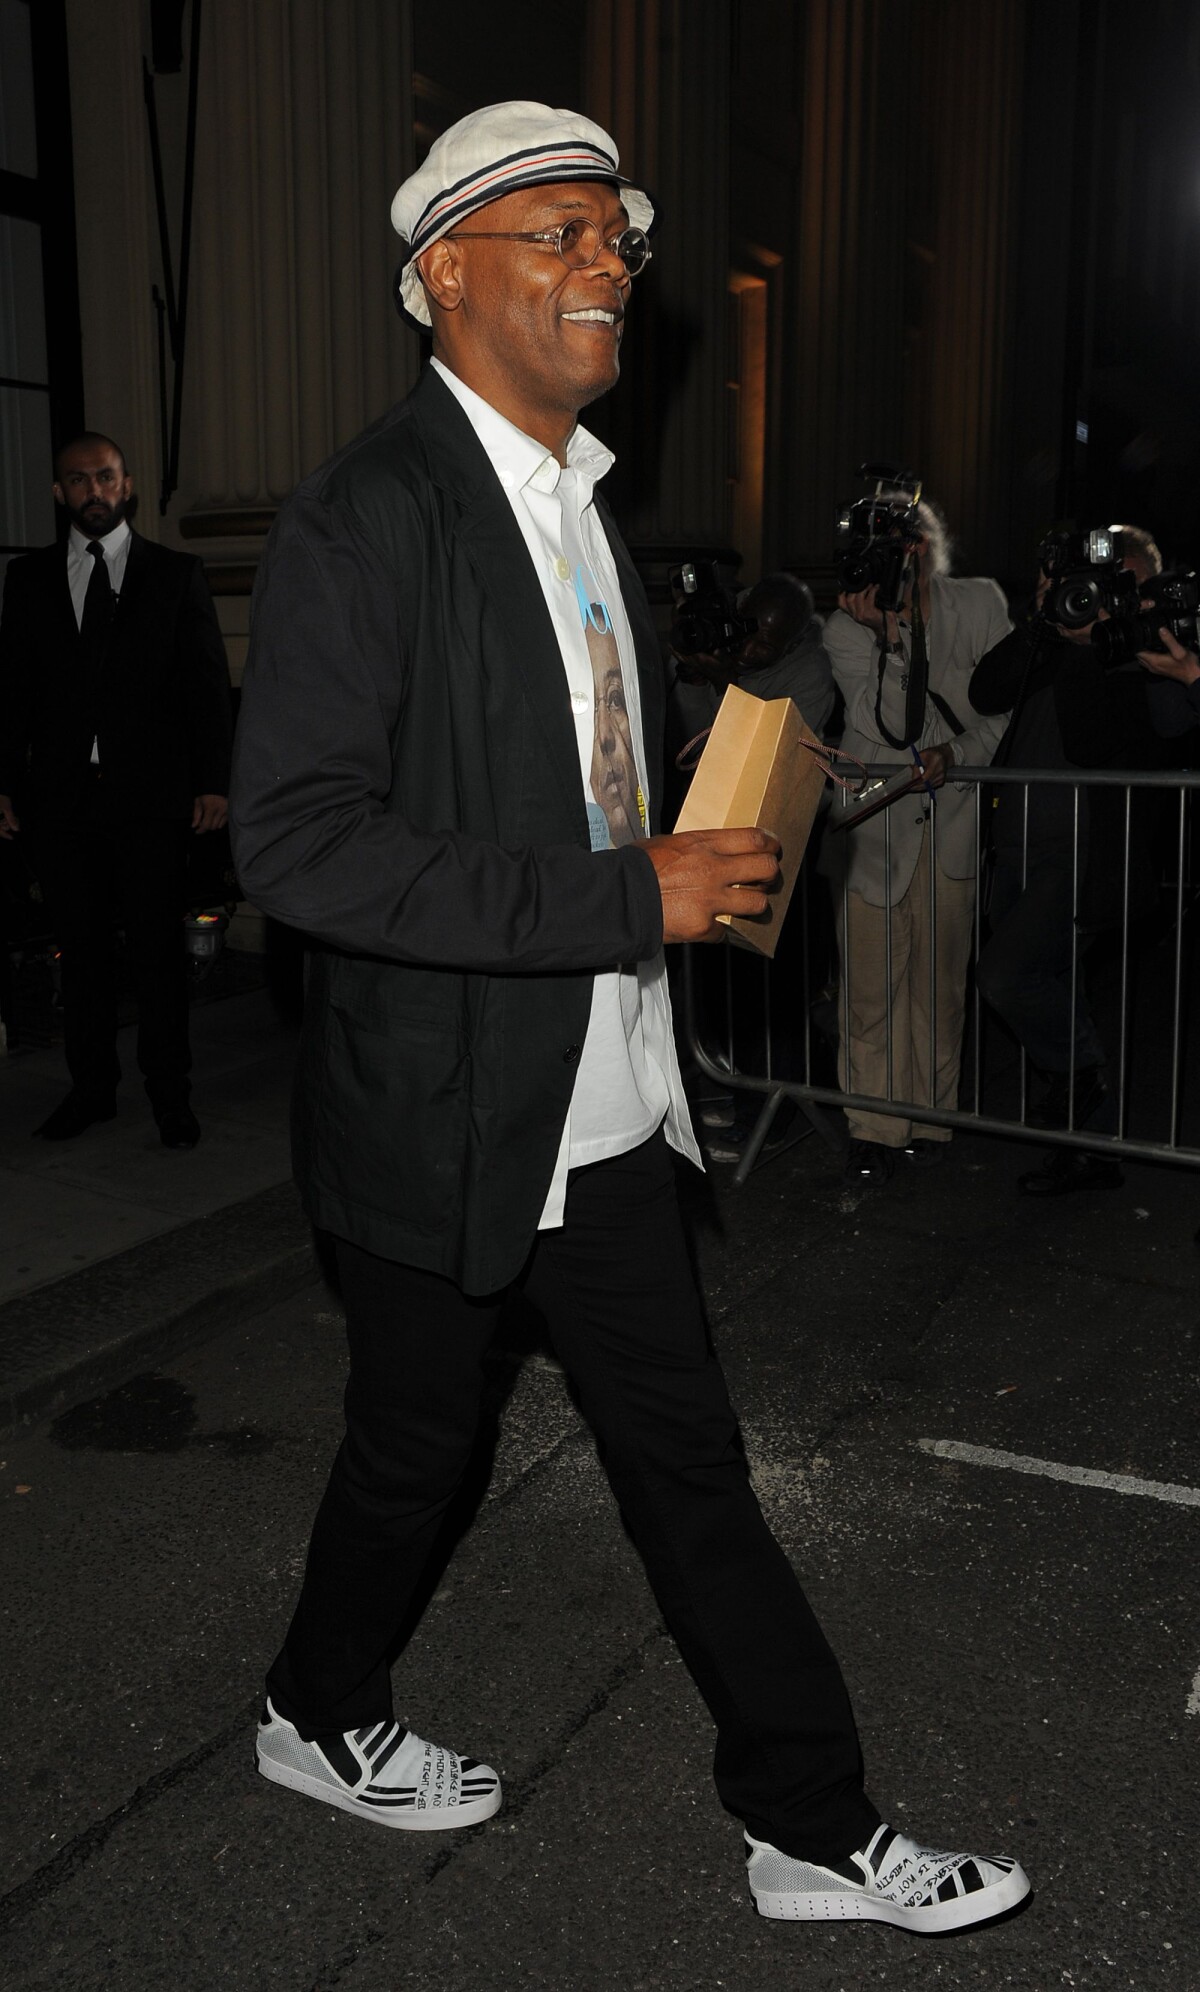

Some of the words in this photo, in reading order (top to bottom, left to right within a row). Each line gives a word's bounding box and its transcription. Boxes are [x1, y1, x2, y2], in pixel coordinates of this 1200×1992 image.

[424, 1743, 432, 1758] THE
[420, 1760, 432, 1787] RIGHT
[432, 1793, 443, 1809] NO
[875, 1858, 913, 1891] WEBSITE
[918, 1863, 931, 1877] IS
[898, 1874, 917, 1895] NOT
